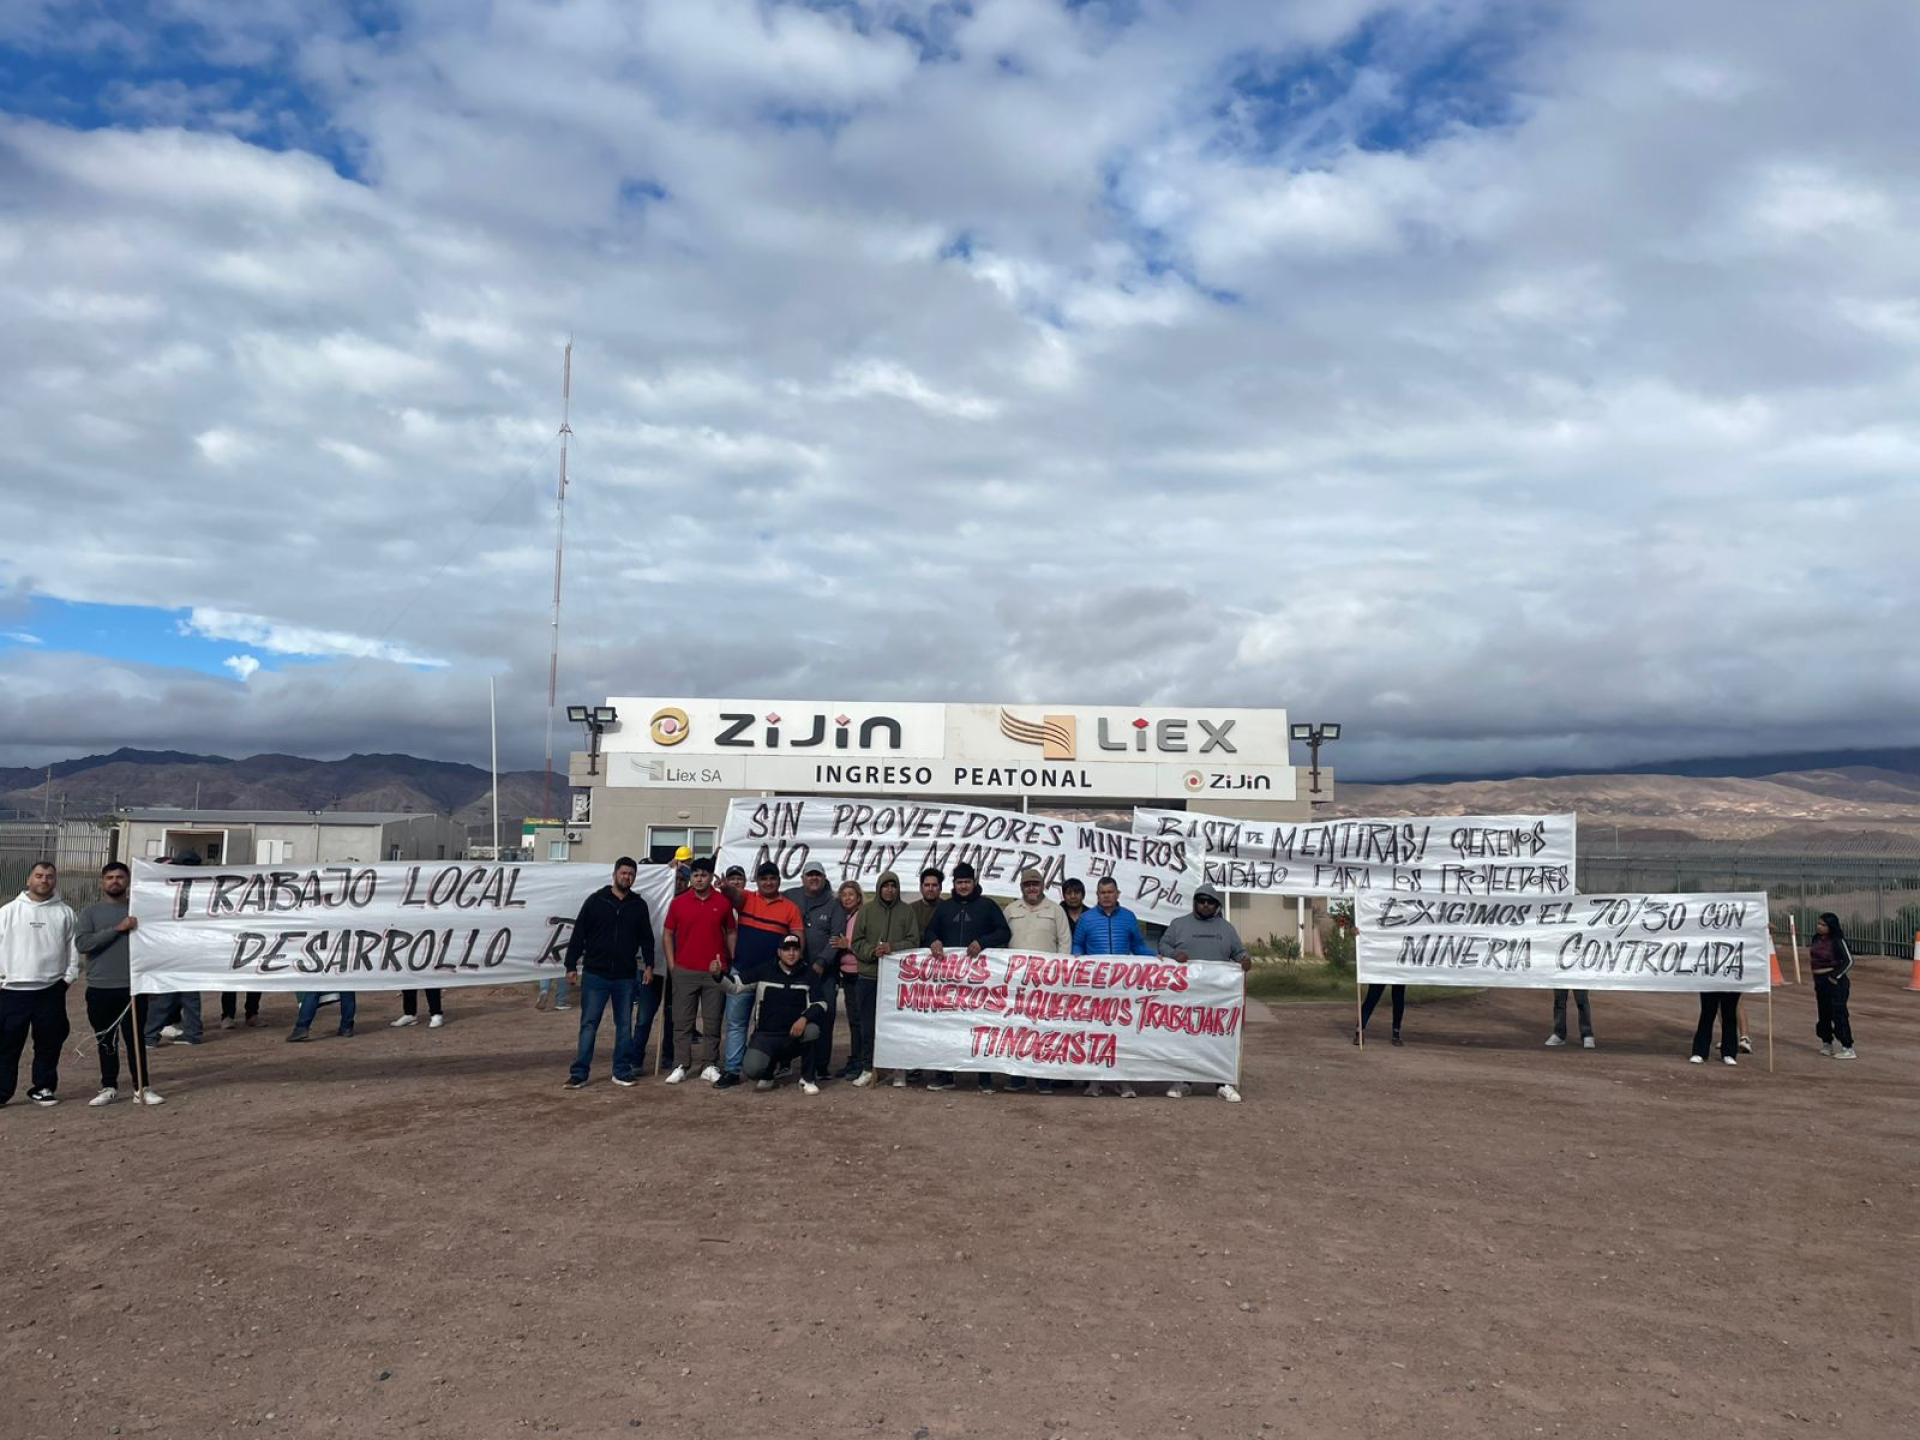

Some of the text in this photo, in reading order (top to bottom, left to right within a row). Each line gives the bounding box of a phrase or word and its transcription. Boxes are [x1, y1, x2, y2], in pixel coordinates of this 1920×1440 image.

[700, 769, 722, 782] SA
[815, 765, 1092, 788] INGRESO PEATONAL
[748, 801, 1189, 875] SIN PROVEEDORES MINEROS
[1245, 831, 1264, 845] DE
[750, 841, 809, 882] NO
[839, 840, 909, 882] HAY
[1085, 857, 1116, 878] EN
[1203, 861, 1289, 889] RABAJO
[166, 866, 526, 920] TRABAJO LOCAL
[1376, 897, 1748, 938] EXIGIMOS EL 70/30 CON
[230, 927, 512, 975] DESARROLLO
[1398, 932, 1744, 980] MINERIA CONTROLADA
[898, 953, 1189, 992] SOMOS PROVEEDORES
[970, 1026, 1117, 1067] TINOGASTA
